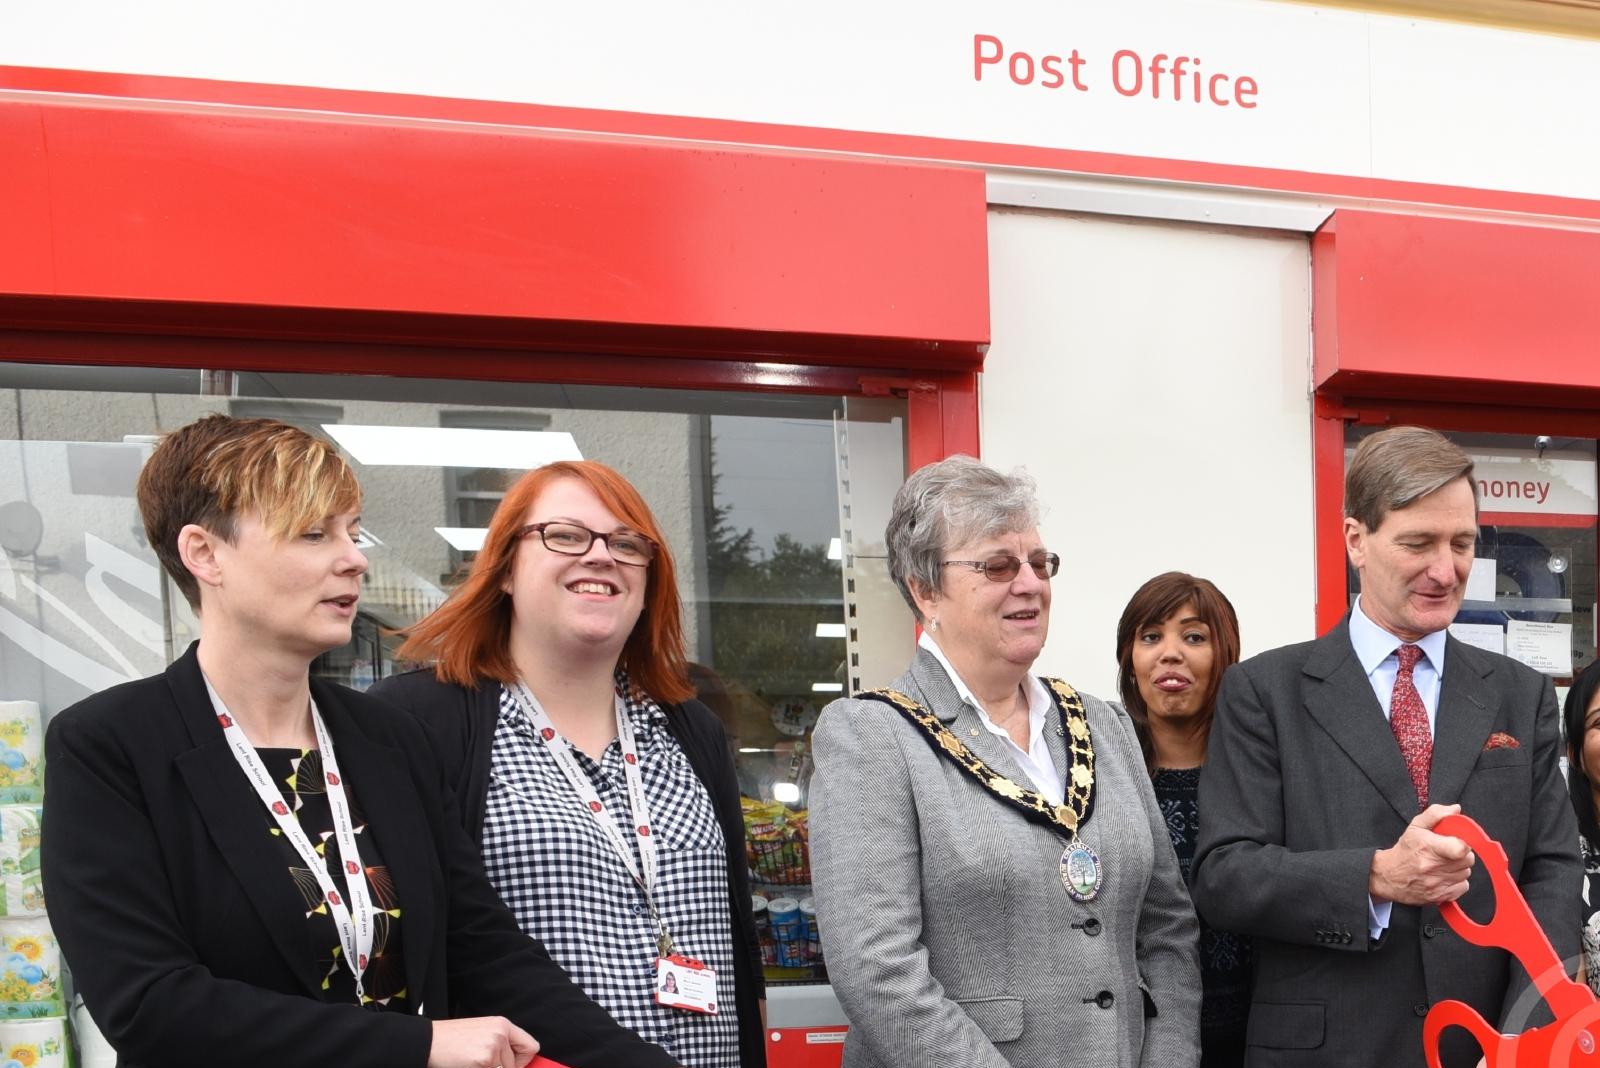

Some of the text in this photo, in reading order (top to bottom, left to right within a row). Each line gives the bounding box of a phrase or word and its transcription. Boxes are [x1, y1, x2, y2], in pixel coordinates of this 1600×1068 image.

[974, 34, 1258, 108] Post Office
[252, 767, 267, 786] School
